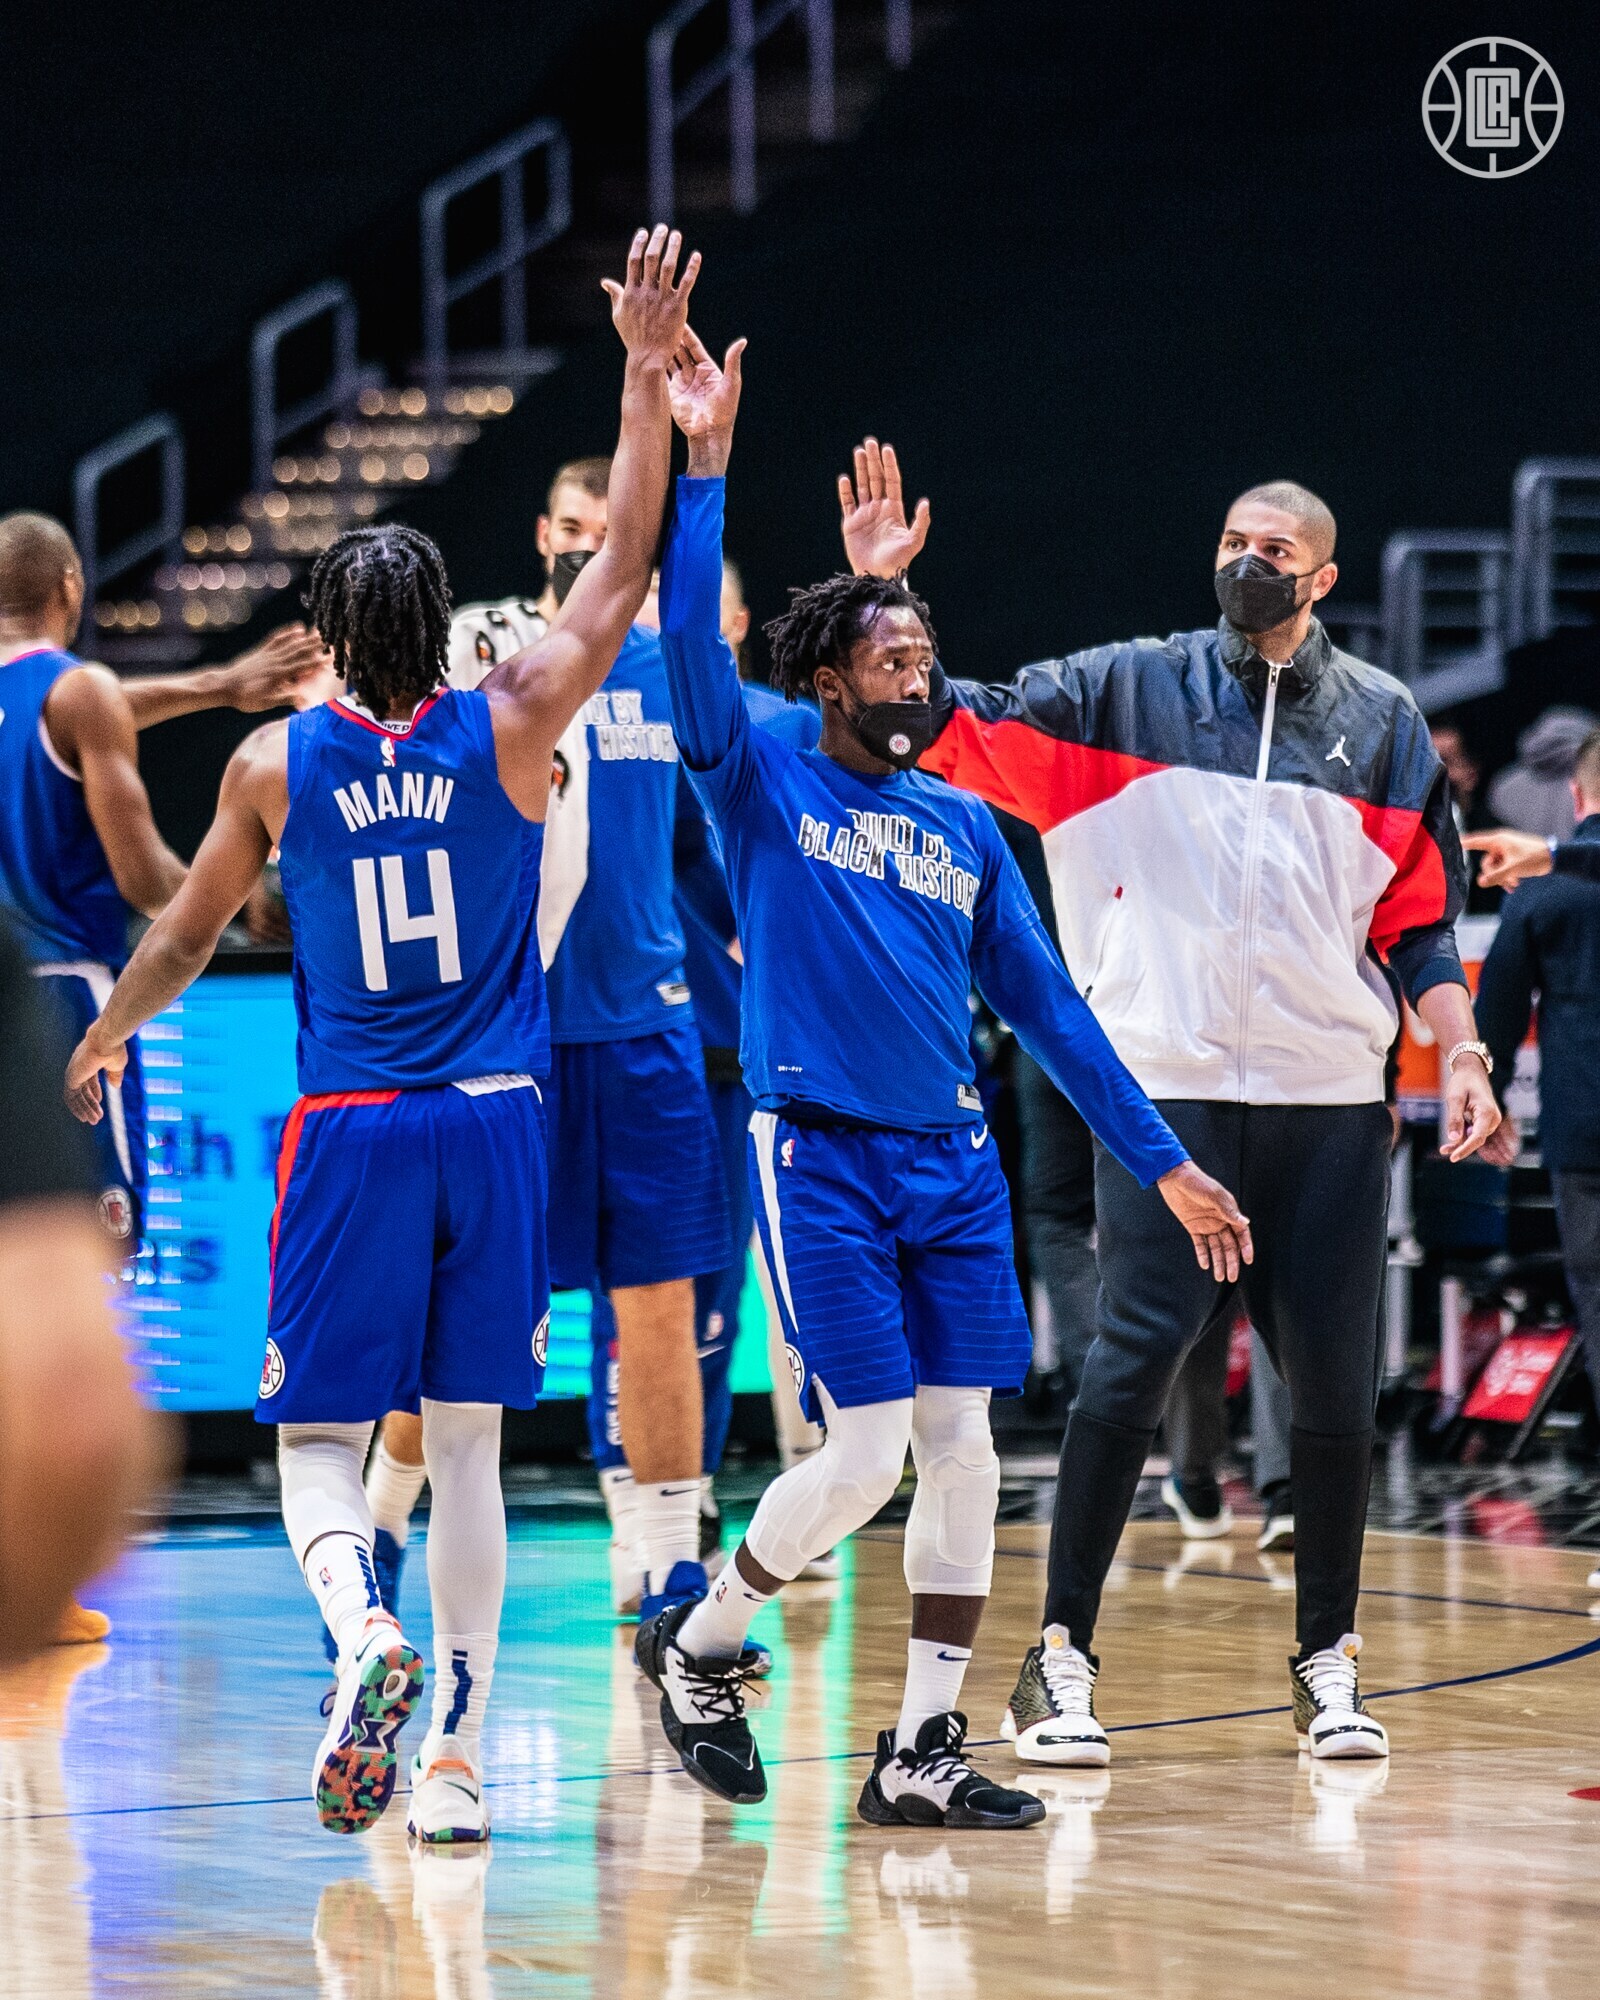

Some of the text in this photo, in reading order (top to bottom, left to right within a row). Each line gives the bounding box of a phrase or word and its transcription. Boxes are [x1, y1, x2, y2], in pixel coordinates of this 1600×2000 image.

[596, 724, 679, 763] HISTOR
[333, 772, 454, 833] MANN
[798, 812, 886, 881] BLACK
[352, 849, 463, 992] 14
